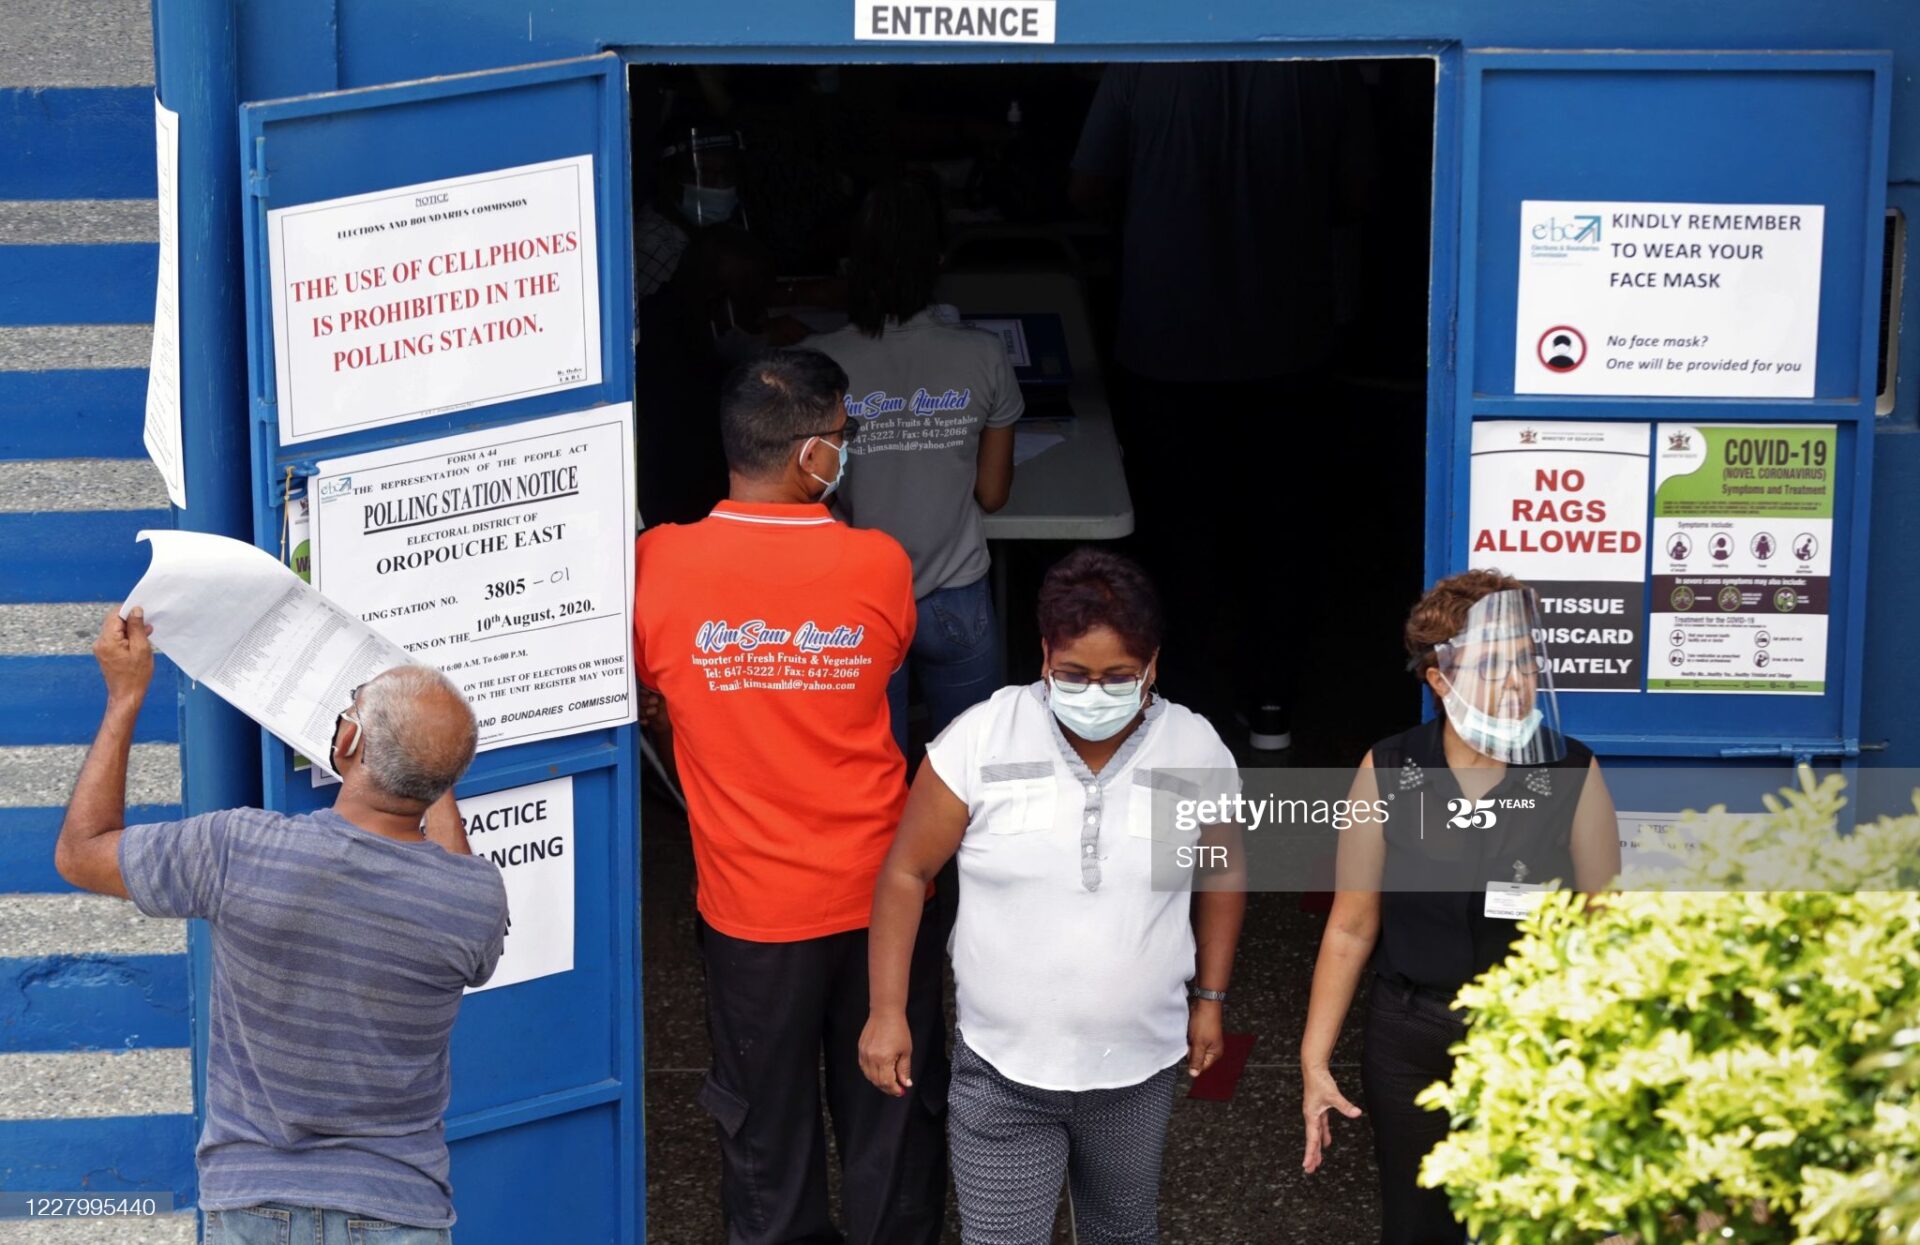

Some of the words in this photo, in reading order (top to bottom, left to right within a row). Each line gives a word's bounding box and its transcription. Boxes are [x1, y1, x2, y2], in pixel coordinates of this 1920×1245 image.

[872, 6, 1038, 36] ENTRANCE
[415, 193, 449, 207] NOTICE
[337, 222, 385, 239] ELECTIONS
[389, 219, 407, 230] AND
[410, 208, 469, 226] BOUNDARIES
[472, 198, 527, 216] COMMISSION
[1612, 213, 1682, 230] KINDLY
[1688, 215, 1801, 231] REMEMBER
[1611, 243, 1637, 258] TO
[1643, 243, 1701, 259] WEAR
[1708, 244, 1763, 260] YOUR
[290, 276, 338, 302] THE
[345, 267, 386, 293] USE
[392, 259, 422, 284] OF
[428, 231, 578, 277] CELLPHONES
[1610, 272, 1656, 288] FACE
[1663, 272, 1721, 288] MASK
[312, 316, 333, 337] IS
[340, 287, 480, 332] PROHIBITED
[486, 282, 509, 305] IN
[514, 273, 560, 299] THE
[333, 334, 434, 372] POLLING
[440, 314, 544, 351] STATION.
[1606, 335, 1627, 347] No
[1630, 334, 1659, 351] face
[1663, 335, 1708, 348] mask?
[1606, 358, 1634, 371] One
[1638, 358, 1662, 371] will
[1666, 358, 1684, 371] be
[1687, 359, 1749, 376] provided
[1751, 360, 1773, 376] for
[1776, 362, 1801, 375] you
[843, 391, 907, 419] imSam
[909, 387, 971, 416] Limited
[860, 422, 869, 432] of
[870, 418, 895, 430] Fresh
[897, 418, 921, 428] Fruits
[934, 415, 978, 428] Vegetables
[852, 431, 894, 444] 47-5222
[902, 430, 920, 440] Fax:
[922, 427, 968, 438] 647-2066
[867, 438, 964, 454] kimsamltd@yahoo.com
[1724, 438, 1828, 466] COVID-19
[447, 452, 476, 465] FORM
[478, 450, 486, 460] A
[487, 448, 498, 458] 44
[352, 484, 374, 496] THE
[380, 466, 471, 491] REPRESENTATION
[476, 462, 490, 473] OF
[497, 456, 517, 468] THE
[524, 448, 563, 464] PEOPLE
[568, 443, 589, 456] ACT
[1723, 467, 1755, 481] (NOVEL
[1758, 468, 1827, 481] CORONAVIRUS)
[1535, 469, 1585, 492] NO
[363, 492, 438, 529] POLLING
[441, 476, 513, 515] STATION
[516, 465, 579, 497] NOTICE
[1722, 484, 1764, 496] Symptoms
[1767, 484, 1782, 494] and
[1785, 484, 1826, 495] Treatment
[1512, 499, 1606, 522] RAGS
[407, 524, 470, 546] ELECTORAL
[472, 515, 521, 535] DISTRICT
[523, 511, 538, 524] OF
[1678, 521, 1709, 529] Symptoms
[376, 534, 509, 575] OROPOUCHE
[514, 523, 566, 548] EAST
[1473, 529, 1642, 553] ALLOWED
[1722, 578, 1753, 586] symptoms
[1754, 578, 1767, 587] may
[359, 610, 389, 623] LING
[390, 599, 436, 619] STATION
[440, 595, 459, 607] NO.
[484, 578, 526, 601] 3805
[559, 598, 596, 618] 2020.
[1540, 598, 1625, 615] TISSUE
[1674, 616, 1705, 624] Treatment
[1706, 616, 1714, 624] for
[1716, 616, 1725, 624] the
[1726, 616, 1755, 624] COVID-19
[431, 637, 447, 648] ON
[448, 632, 471, 646] THE
[695, 619, 791, 653] KimSam
[793, 620, 864, 653] Limited
[1531, 628, 1634, 645] DISCARD
[446, 661, 463, 673] 6:00
[463, 658, 482, 669] A.M.
[482, 655, 493, 665] To
[493, 652, 509, 663] 6:00
[510, 649, 529, 659] P.M.
[691, 654, 732, 667] Importer
[735, 653, 744, 663] of
[747, 653, 775, 663] Fresh
[777, 653, 807, 665] Fruits
[810, 655, 820, 665] &
[822, 655, 872, 667] Vegetables
[1538, 658, 1633, 675] DIATELY
[463, 683, 477, 692] ON
[479, 679, 496, 690] THE
[497, 674, 516, 685] LIST
[518, 672, 531, 681] OF
[533, 664, 577, 679] ELECTORS
[579, 660, 592, 670] OR
[593, 655, 625, 668] WHOSE
[704, 668, 722, 679] Tel:
[724, 666, 775, 678] 647-5222
[777, 665, 782, 677] /
[784, 666, 805, 677] Fax:
[808, 667, 860, 678] 647-2066
[477, 693, 487, 702] IN
[490, 688, 507, 699] THE
[509, 684, 531, 695] UNIT
[534, 676, 577, 690] REGISTER
[578, 672, 599, 683] MAY
[601, 667, 625, 679] VOTE
[709, 679, 742, 692] E-mail:
[743, 679, 856, 691] kimsamltd@yahoo.com
[501, 705, 564, 724] BOUNDARIES
[568, 692, 629, 712] COMMISSION
